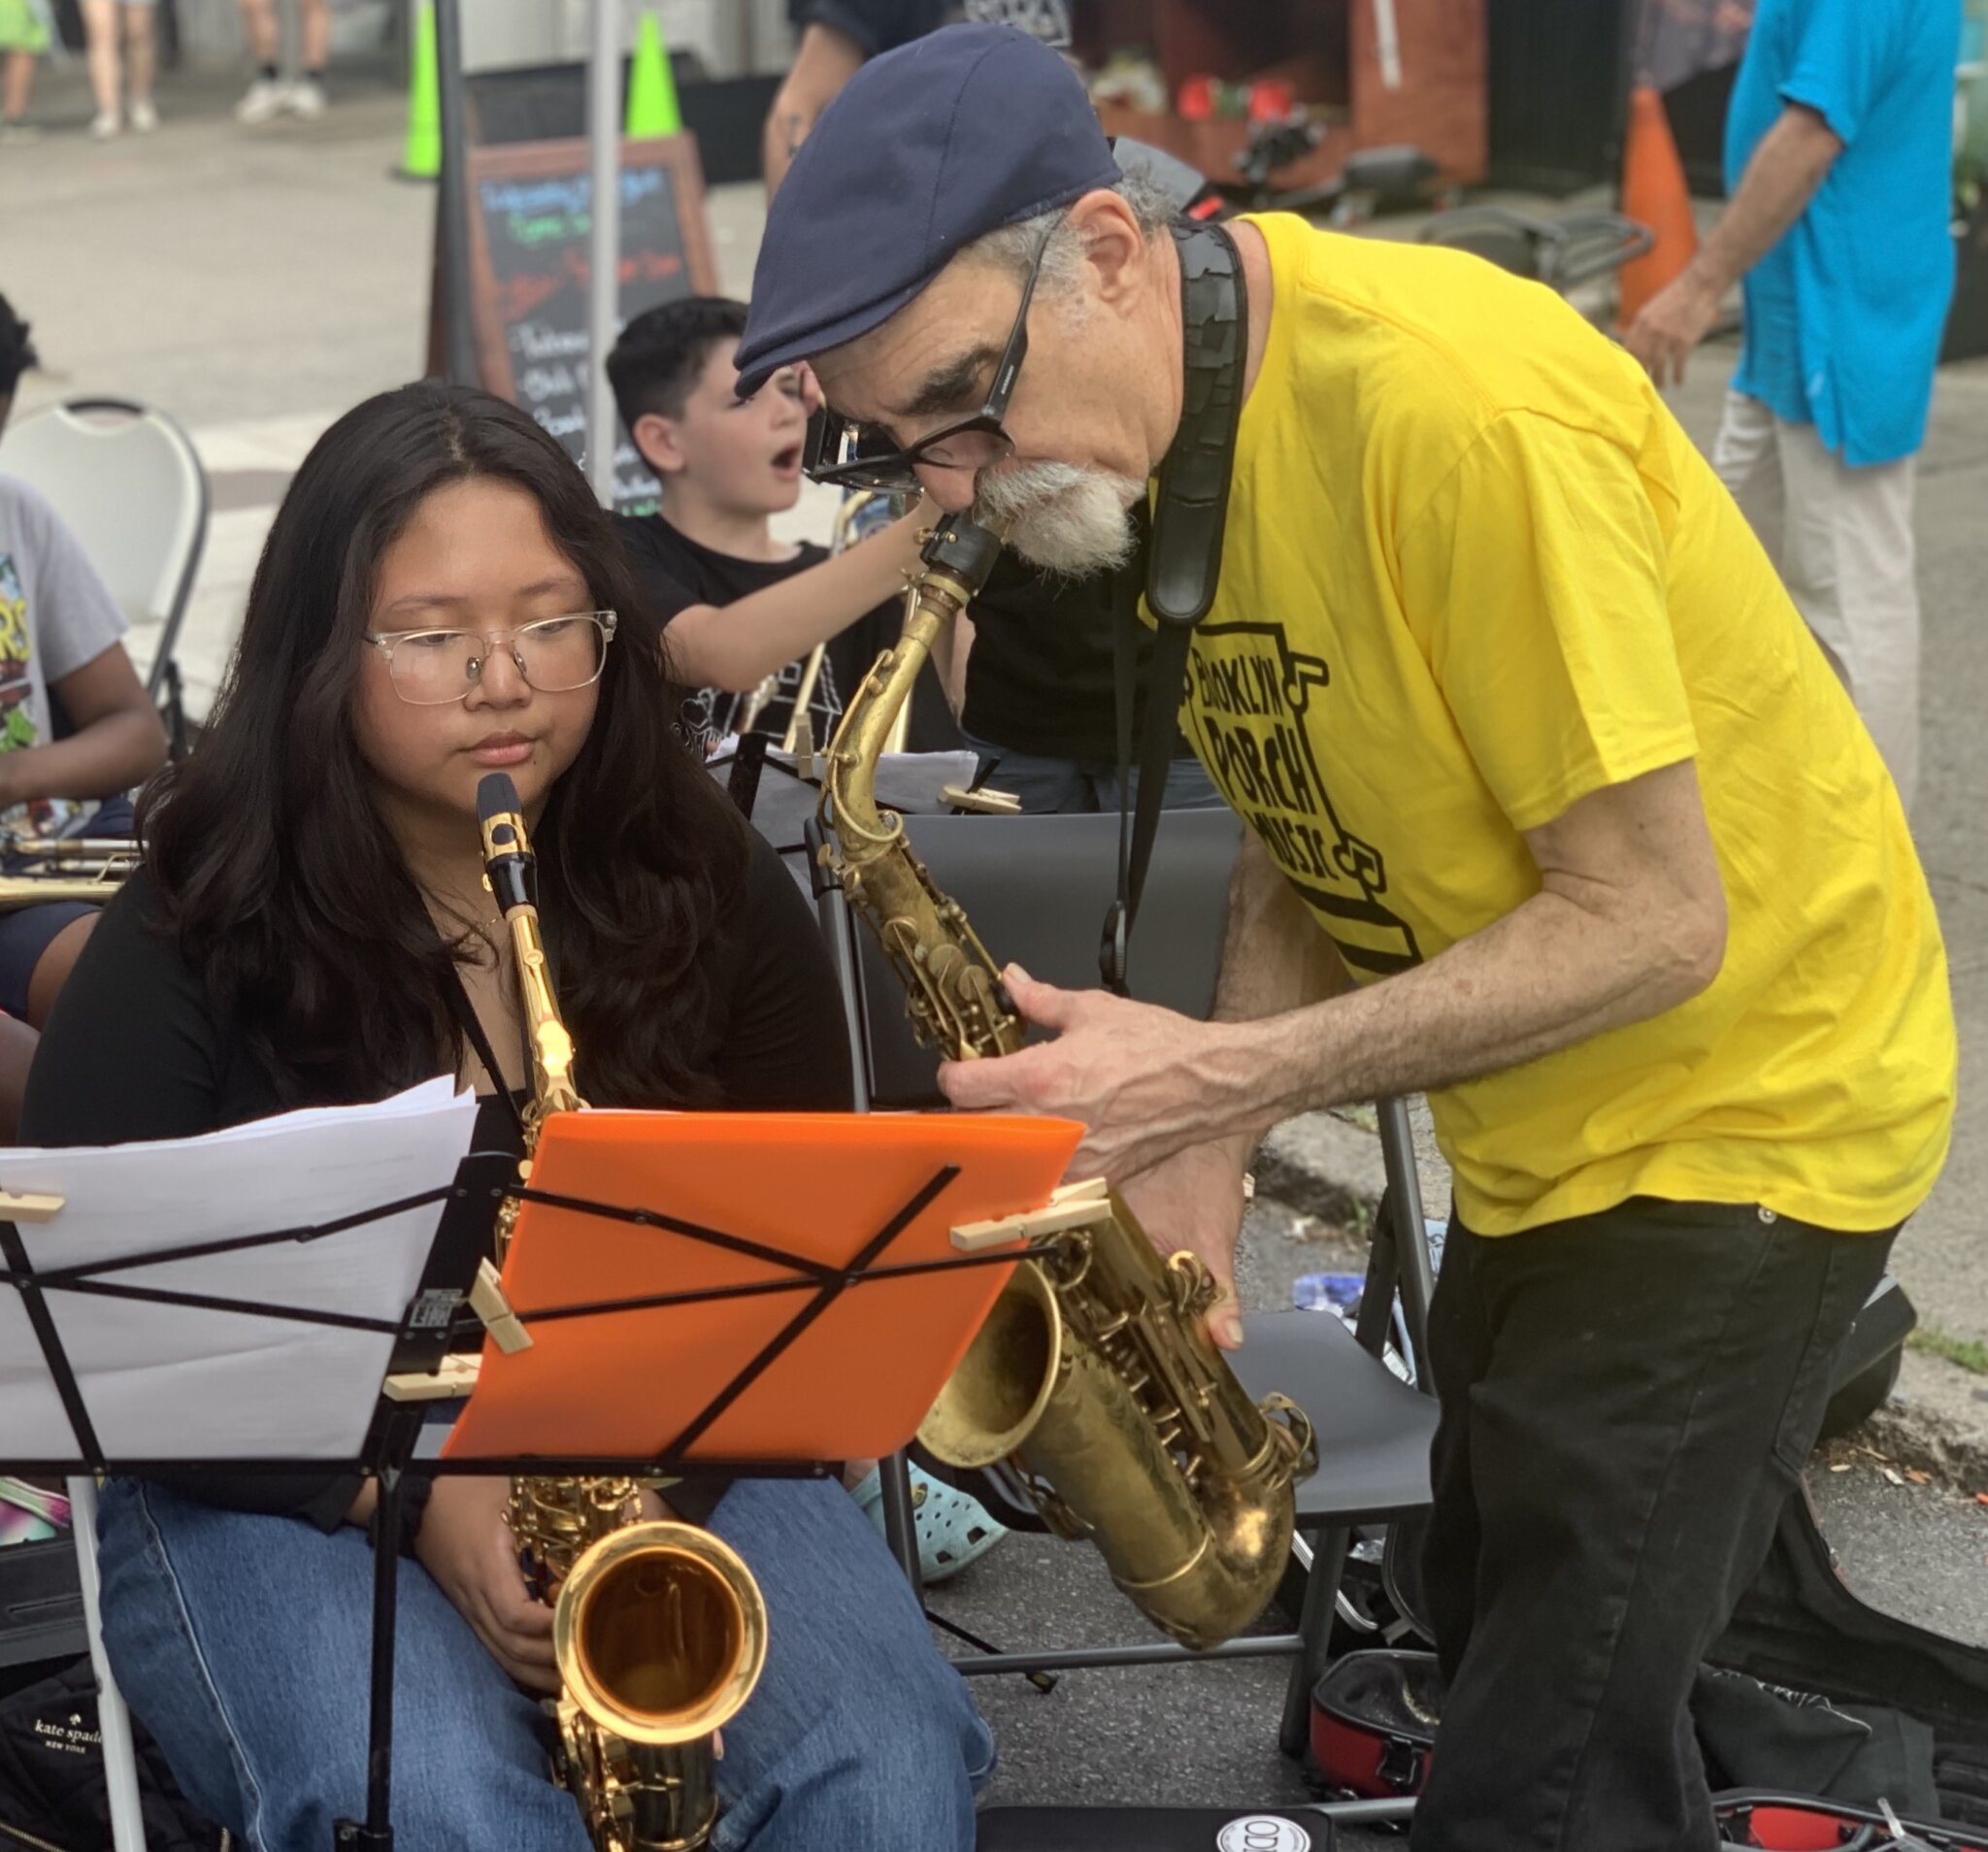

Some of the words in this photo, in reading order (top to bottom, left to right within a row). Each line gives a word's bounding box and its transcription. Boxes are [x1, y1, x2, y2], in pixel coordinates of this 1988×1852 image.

[1191, 646, 1284, 716] BOKLYN
[1203, 715, 1317, 815] PORCH
[35, 1719, 65, 1736] kate
[45, 1739, 64, 1750] NEW
[65, 1743, 86, 1754] YORK
